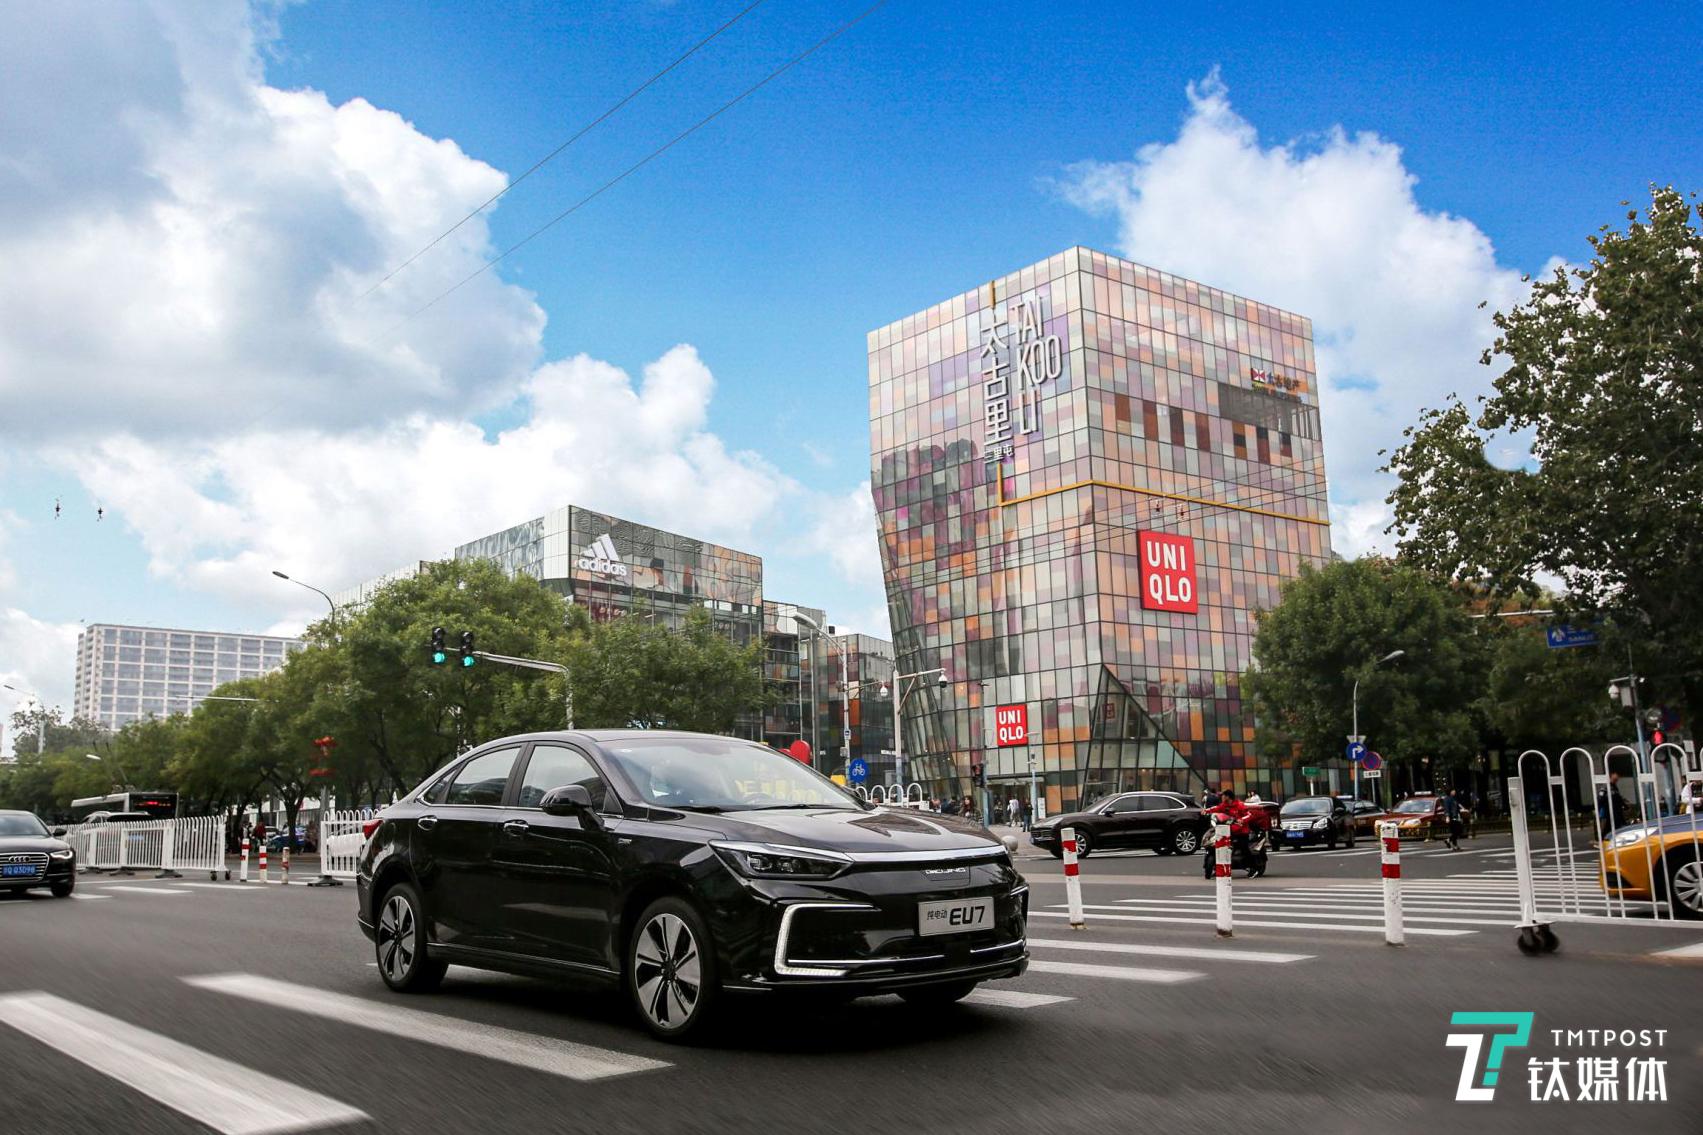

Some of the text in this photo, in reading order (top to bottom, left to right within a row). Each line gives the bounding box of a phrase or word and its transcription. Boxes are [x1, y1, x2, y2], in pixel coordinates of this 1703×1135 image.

[1010, 294, 1044, 344] TAI
[981, 309, 1013, 446] 太古里
[1016, 334, 1062, 391] KOO
[1019, 388, 1038, 435] LI
[578, 557, 627, 577] adidas
[1146, 541, 1186, 571] UNI
[1149, 573, 1192, 605] QLO
[998, 709, 1021, 725] UNI
[1000, 726, 1024, 743] QLO
[949, 905, 985, 926] EU7
